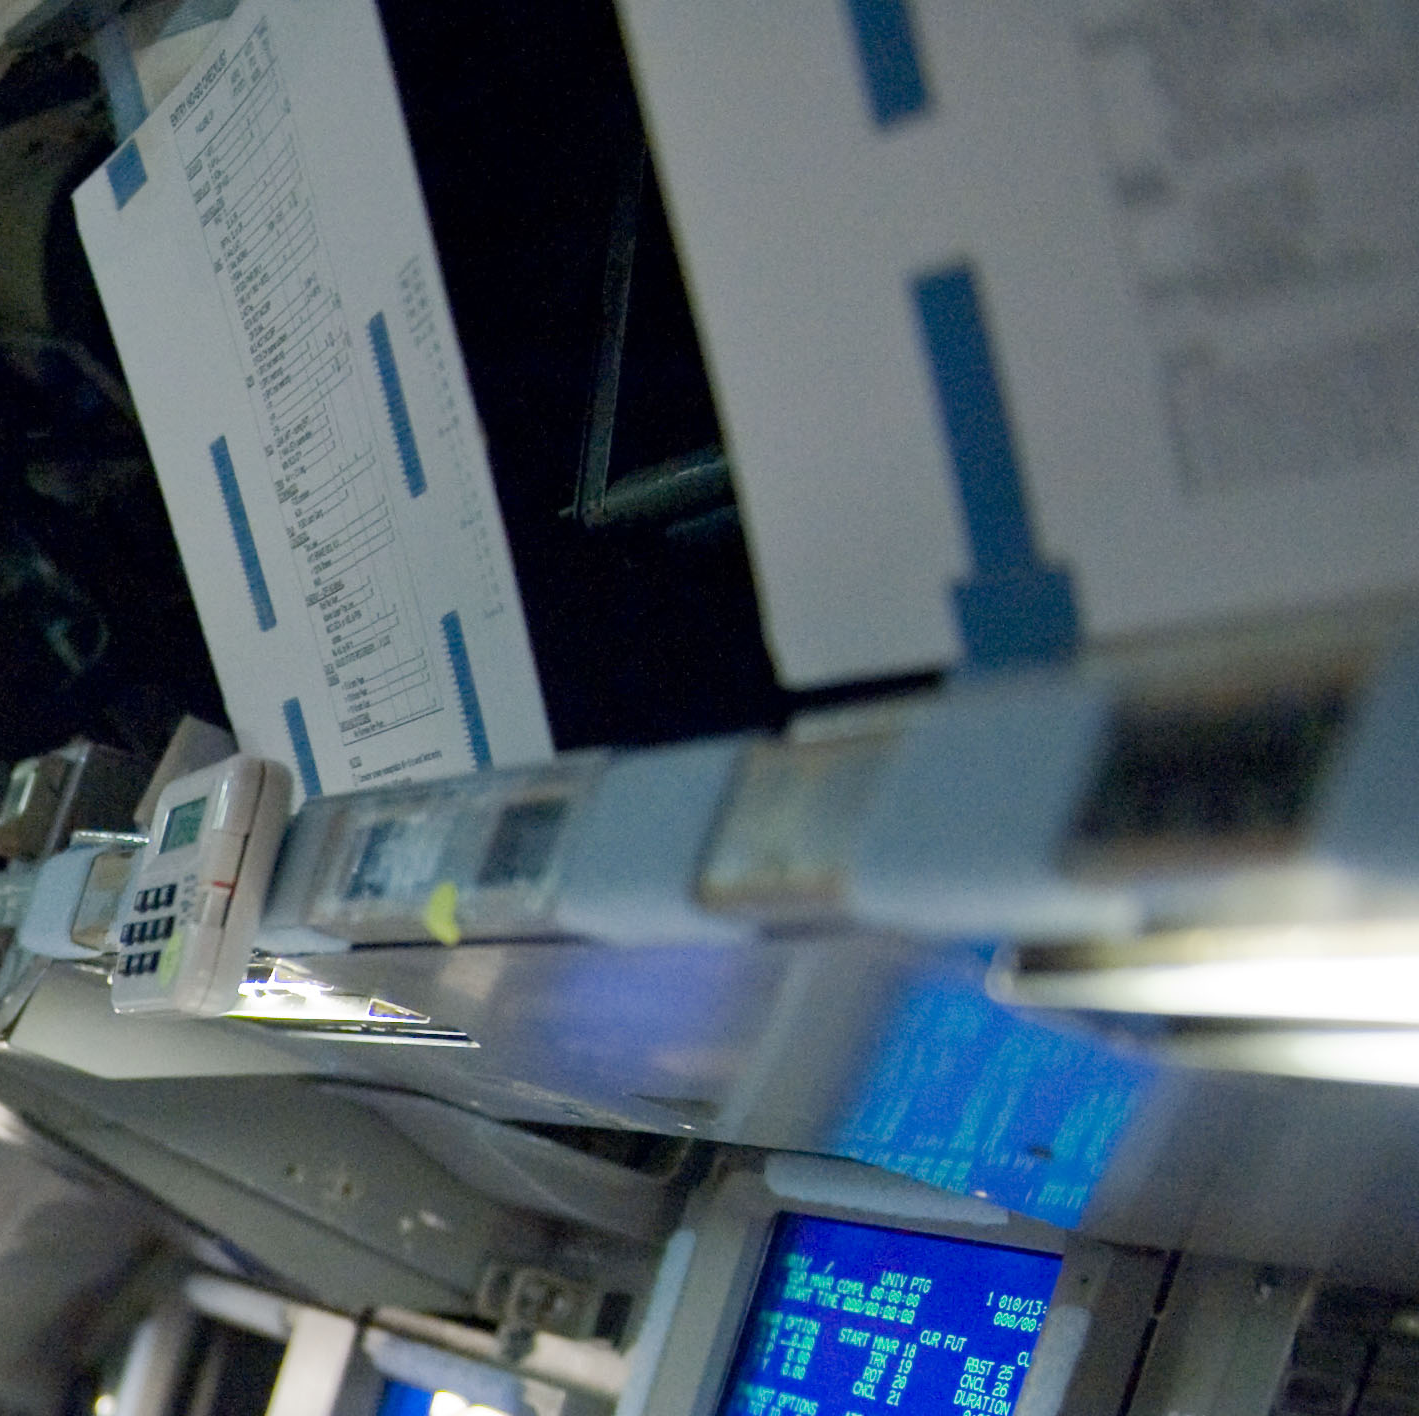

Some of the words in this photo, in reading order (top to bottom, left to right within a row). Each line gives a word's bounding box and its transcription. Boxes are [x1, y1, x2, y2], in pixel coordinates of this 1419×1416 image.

[879, 1271, 907, 1289] UNIV
[909, 1276, 933, 1294] PTG
[814, 1290, 841, 1308] TIME
[837, 1327, 870, 1348] START
[902, 1343, 917, 1358] 18
[917, 1329, 942, 1347] CUR
[943, 1334, 967, 1352] FUT
[861, 1367, 883, 1383] ROT
[897, 1358, 913, 1374] 19
[996, 1364, 1015, 1381] 25
[957, 1373, 989, 1393] CNCL
[991, 1381, 1009, 1398] 26
[885, 1390, 902, 1406] 21
[952, 1390, 1011, 1416] DURATION
